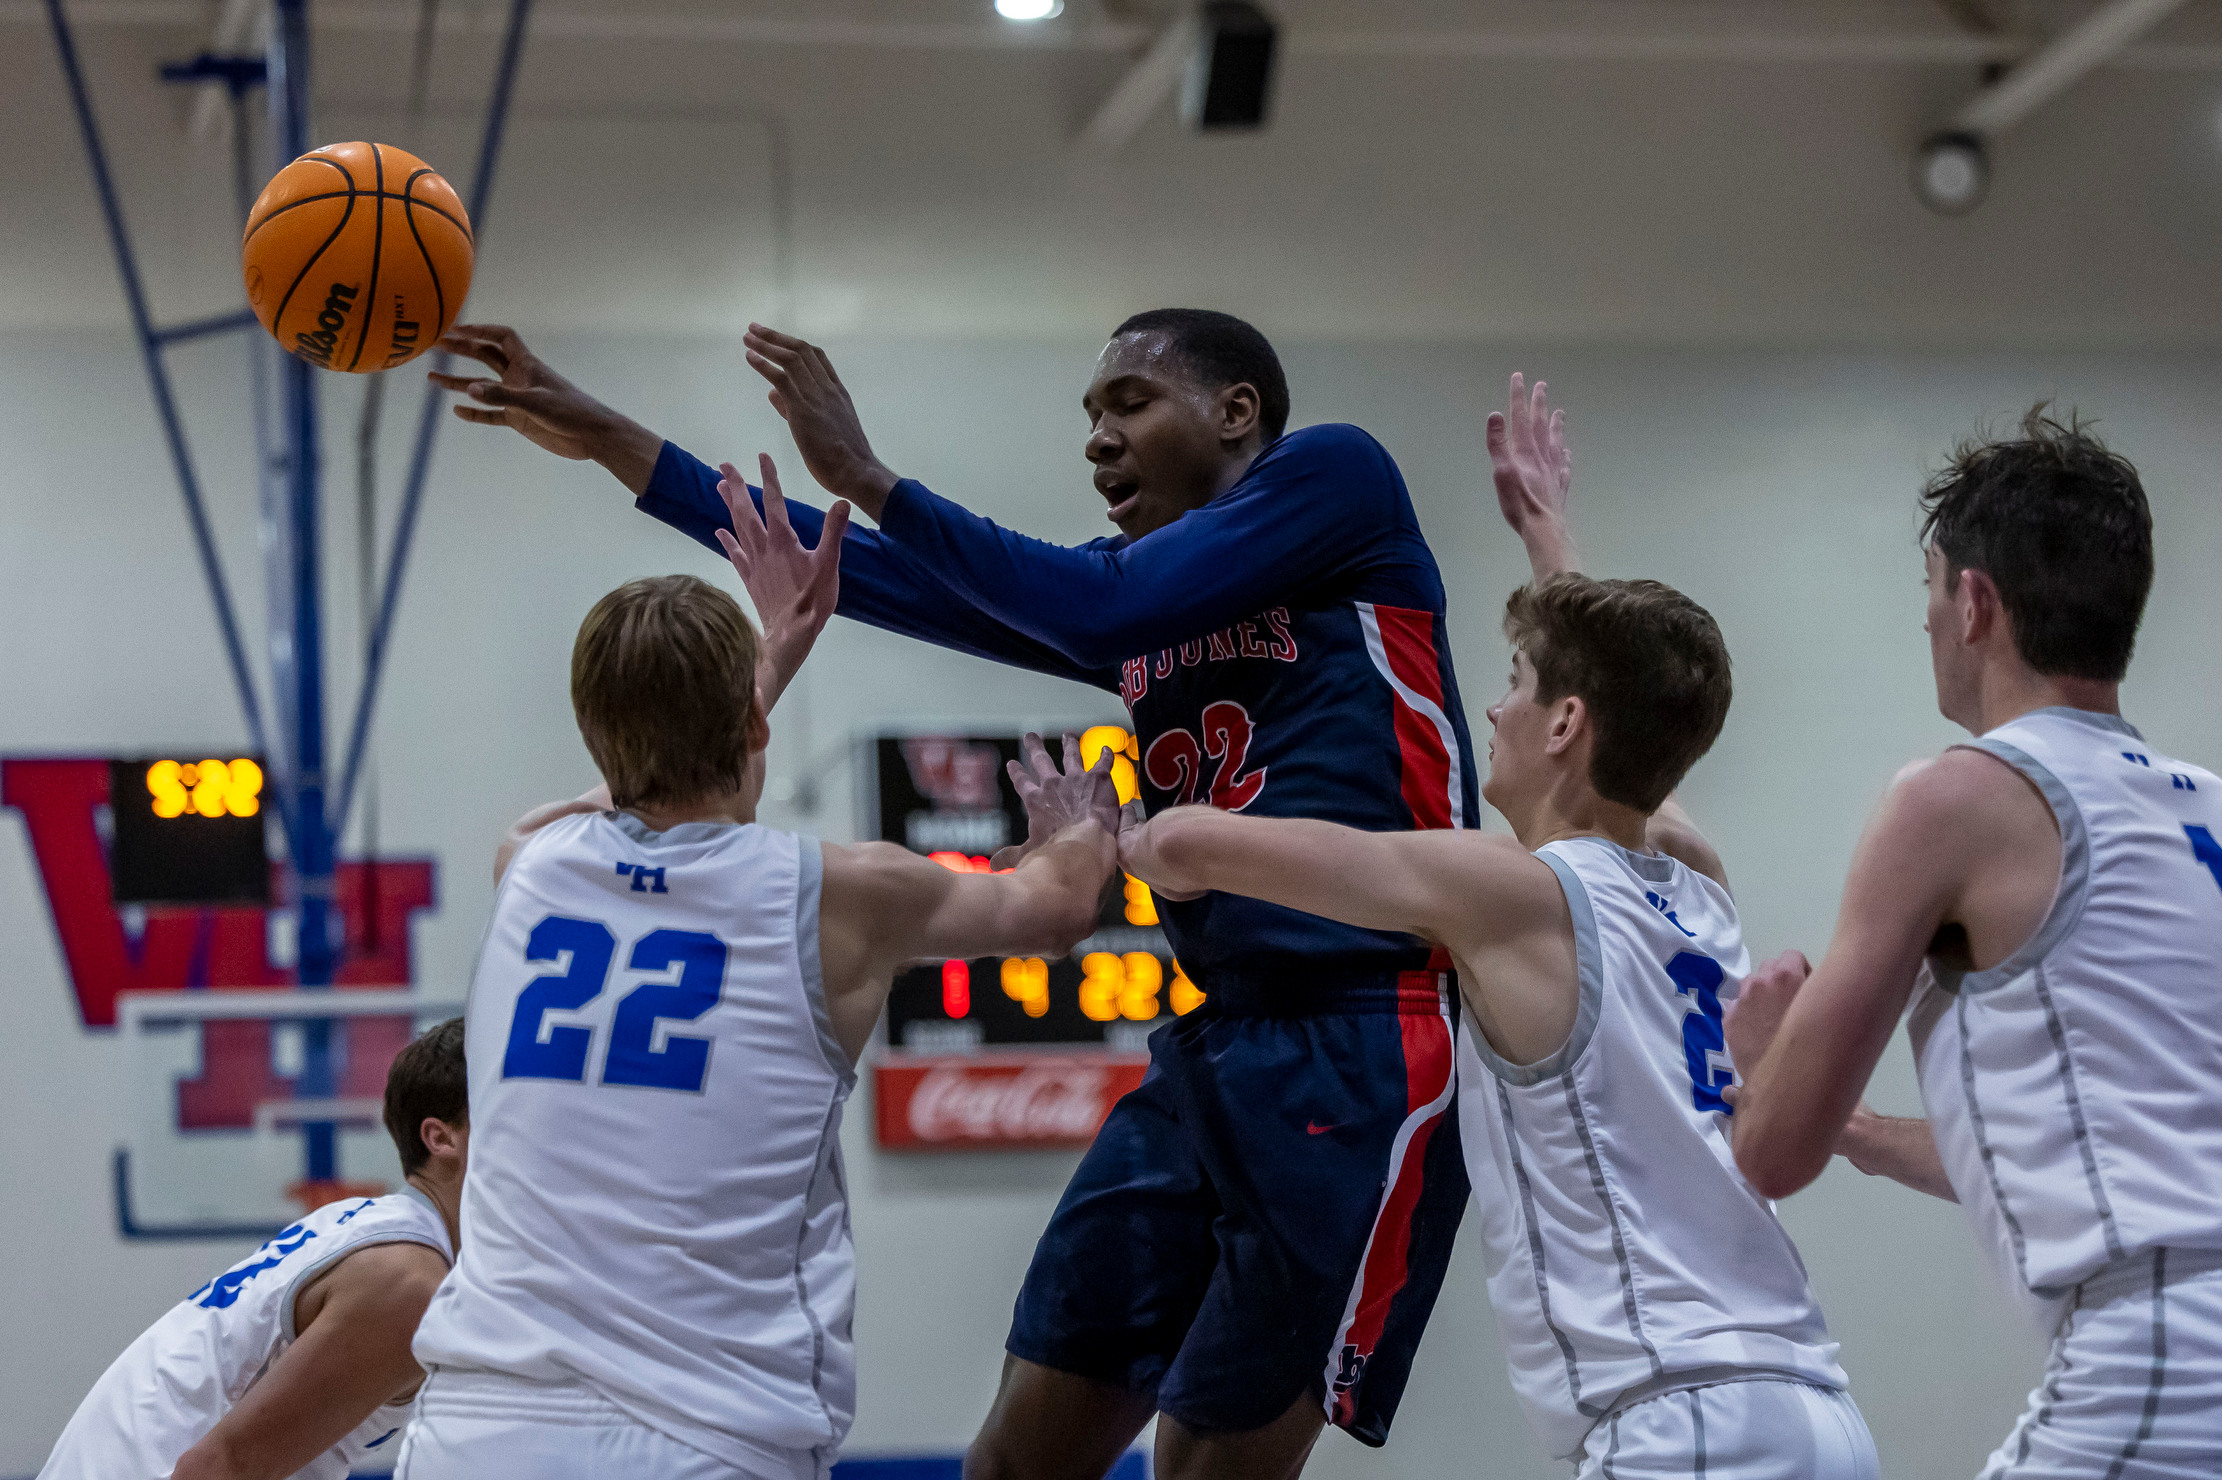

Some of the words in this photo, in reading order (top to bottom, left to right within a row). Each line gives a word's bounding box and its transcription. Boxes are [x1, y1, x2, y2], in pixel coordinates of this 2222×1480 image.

[294, 282, 360, 369] ilson
[1145, 700, 1268, 814] 22
[501, 914, 731, 1096] 22
